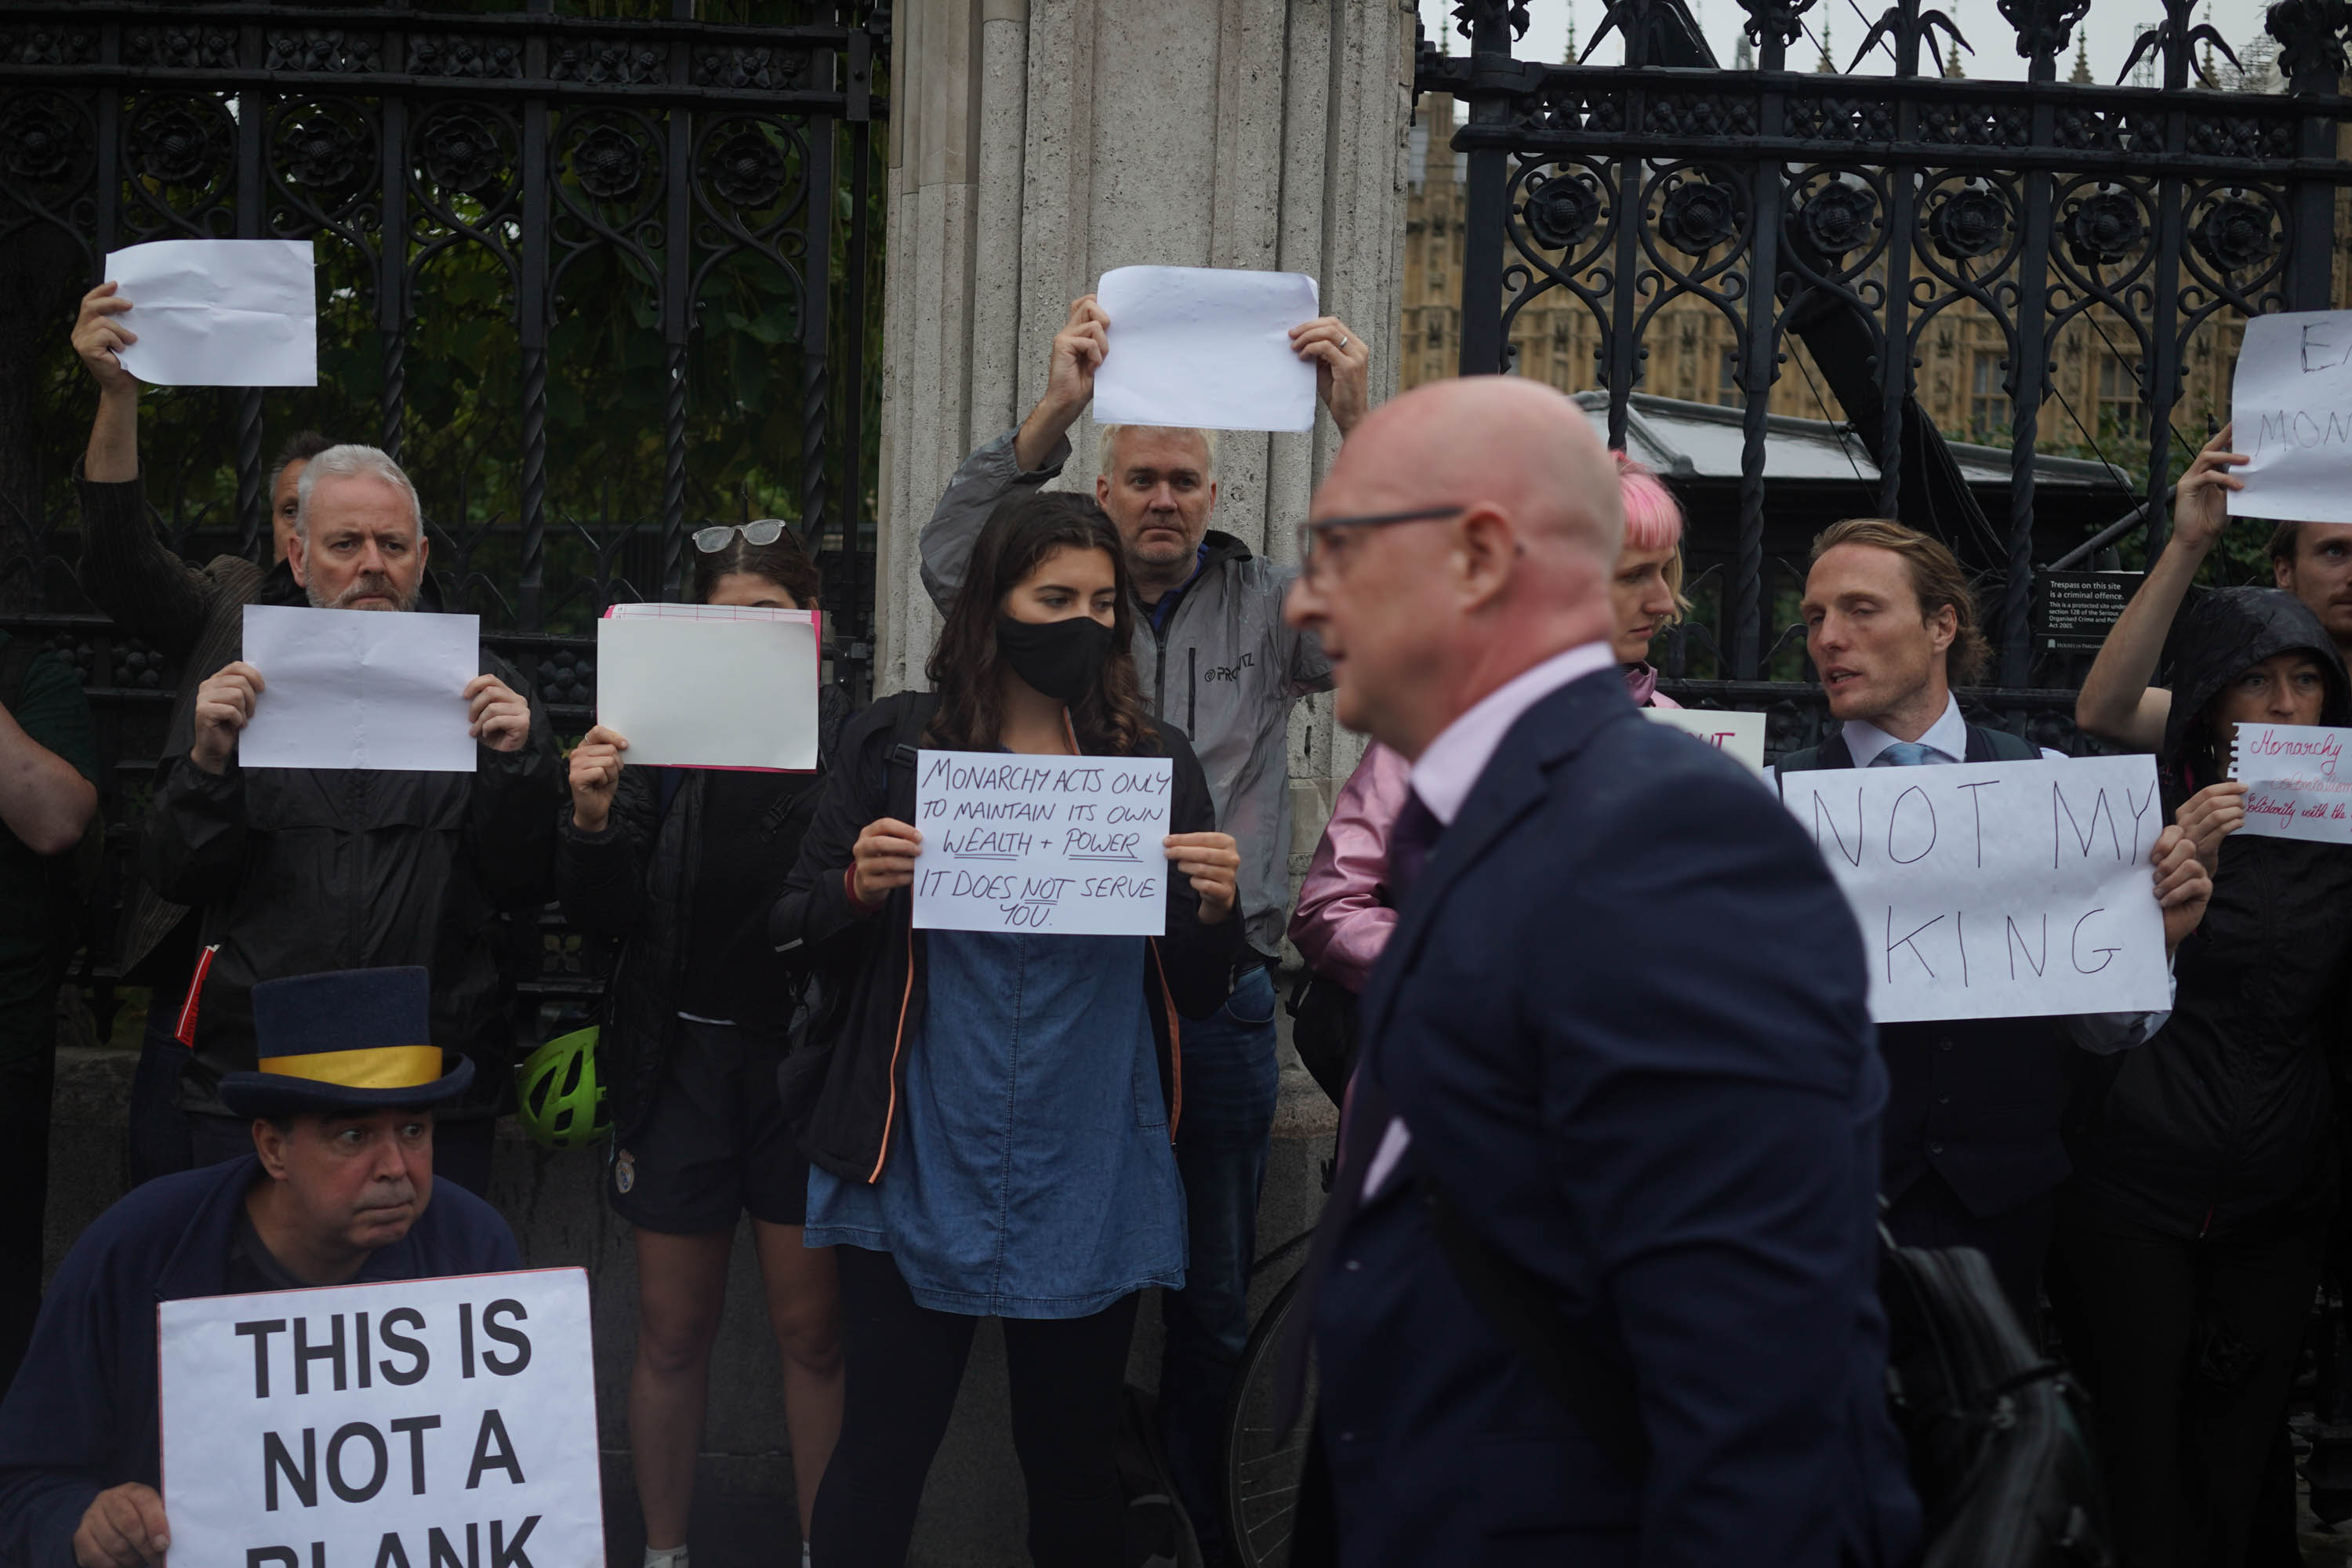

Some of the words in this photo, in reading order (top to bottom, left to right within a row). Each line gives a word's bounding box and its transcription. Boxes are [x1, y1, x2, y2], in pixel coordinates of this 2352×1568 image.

[2050, 580, 2080, 590] Trespass
[2072, 601, 2100, 610] protected
[2250, 729, 2343, 775] Monarchy
[922, 758, 1051, 793] MONARCHY
[1053, 768, 1104, 793] ACTS
[1112, 771, 1171, 795] ONLY
[924, 798, 946, 819] TO
[953, 801, 1056, 822] MAINTAIN
[1068, 804, 1098, 821] ITS
[1107, 805, 1163, 824] OWN
[1813, 781, 2000, 868] NOT
[2053, 780, 2155, 869] MY
[2302, 803, 2328, 819] with
[2331, 803, 2347, 819] the
[943, 827, 1033, 855] WEALTH
[1062, 828, 1140, 858] POWER
[920, 869, 952, 897] IT
[952, 870, 1018, 899] DOES
[1020, 877, 1076, 900] NOT
[1080, 875, 1156, 898] SERVE
[1000, 903, 1053, 927] YOU.
[1886, 905, 2122, 988] KING
[234, 1306, 430, 1399] THIS
[458, 1298, 532, 1379] IS
[263, 1414, 441, 1512] NOT
[465, 1408, 526, 1490] A
